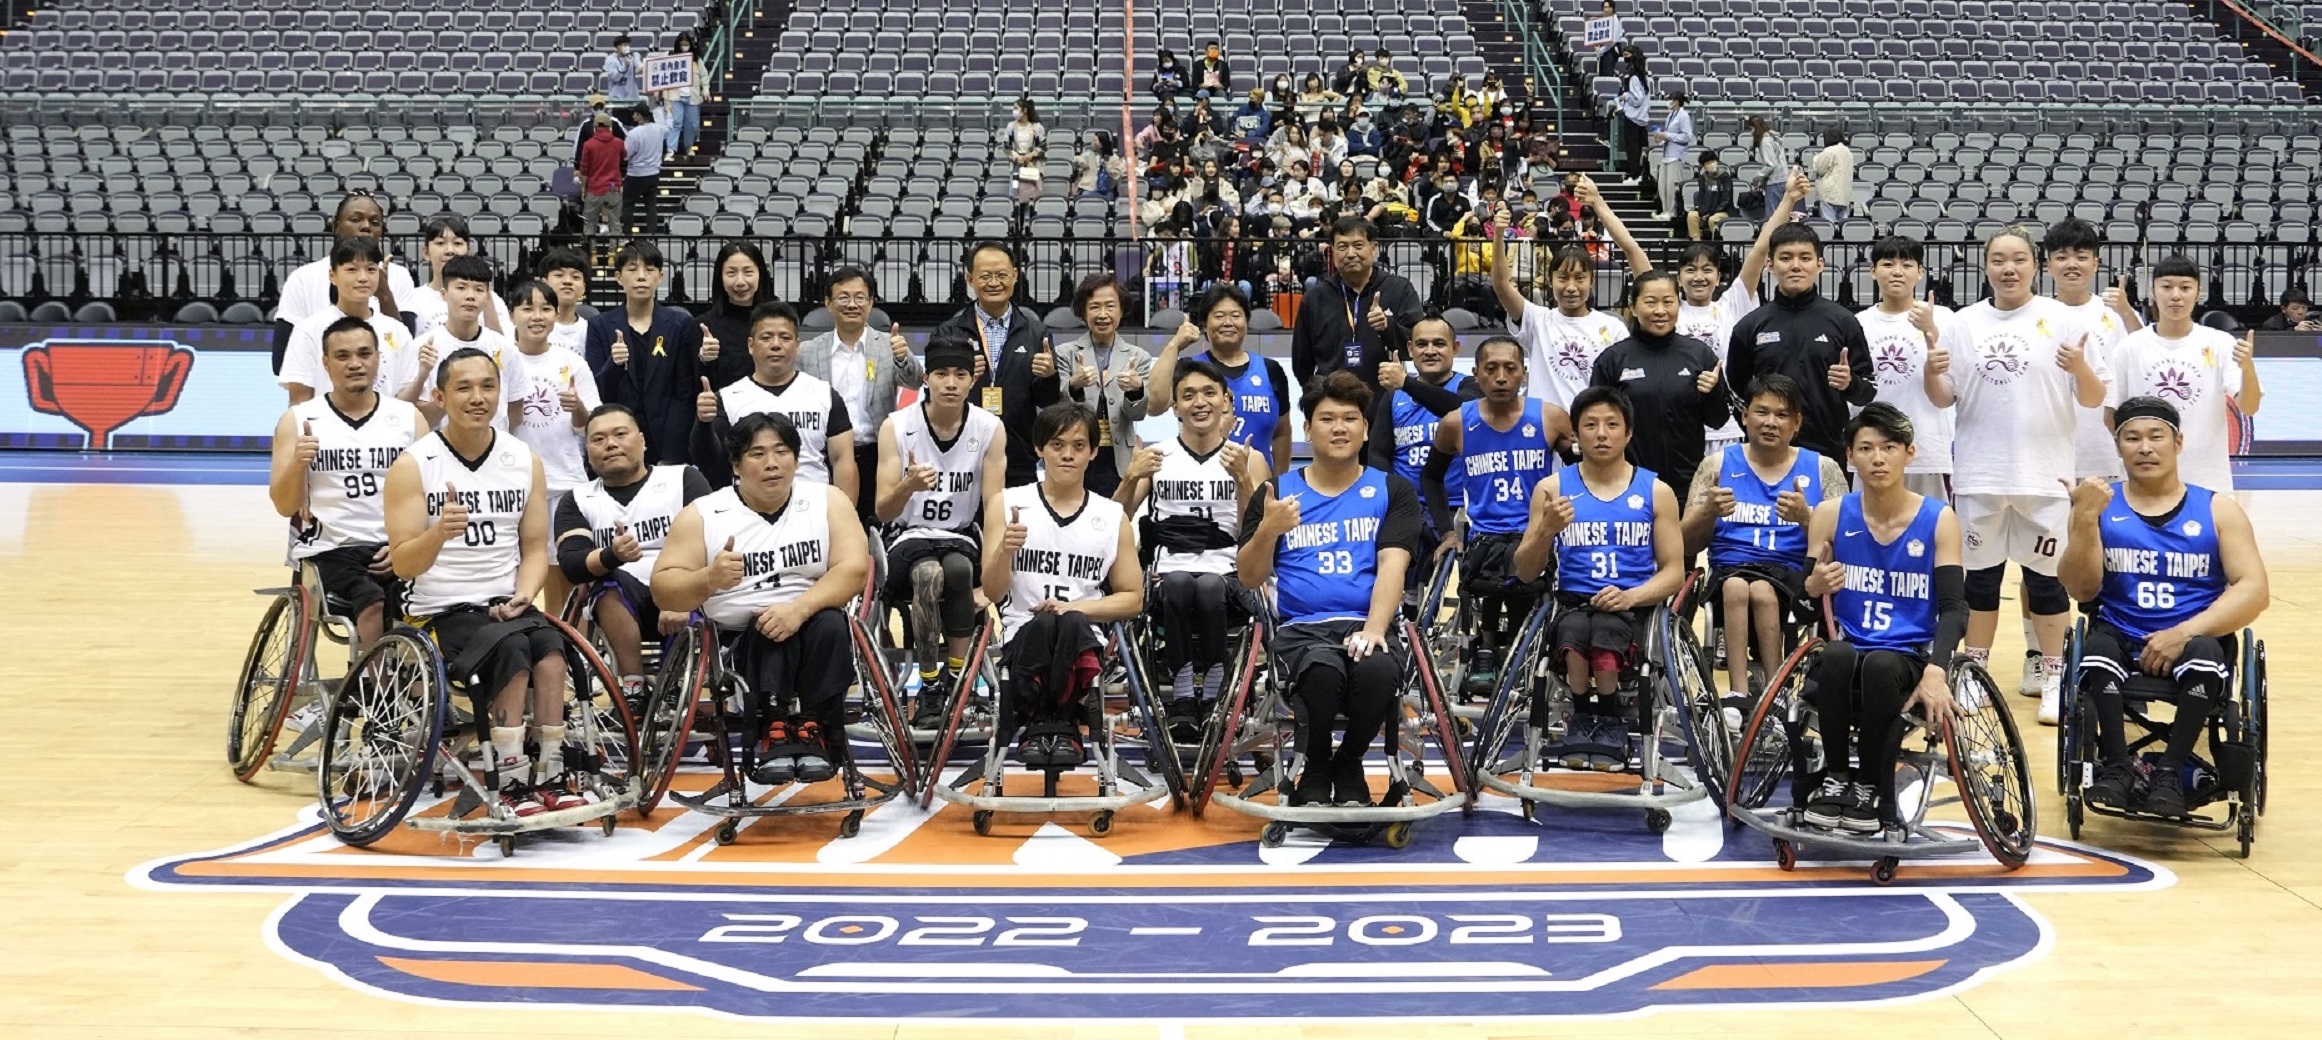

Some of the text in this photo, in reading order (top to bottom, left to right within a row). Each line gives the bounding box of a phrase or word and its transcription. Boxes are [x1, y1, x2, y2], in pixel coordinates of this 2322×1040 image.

[1241, 395, 1271, 414] TAIPEI
[788, 411, 821, 431] TAIPEI
[1229, 417, 1245, 437] 7
[369, 446, 407, 469] TAIP
[1465, 449, 1546, 477] CHINESE TAIPEI
[343, 472, 378, 499] 99
[949, 471, 975, 493] TAIP
[1157, 480, 1238, 501] CHINESE TAIP
[1494, 476, 1524, 502] 34
[487, 487, 525, 513] TAIPEI
[922, 499, 953, 521] 66
[464, 520, 496, 547] 00
[1614, 521, 1651, 547] TAIPEI
[1752, 527, 1776, 551] 11
[2033, 535, 2058, 558] 10
[743, 538, 822, 577] NESE TAIPEI
[1067, 553, 1104, 581] TAIPEI
[1318, 550, 1353, 574] 33
[1591, 552, 1619, 579] 31
[2104, 547, 2210, 578] CHINESE TAIPEI
[1843, 563, 1930, 600] HINESE TAIPEI
[2137, 581, 2175, 609] 66
[1861, 600, 1894, 631] 15
[698, 914, 1088, 946] 2022
[1248, 914, 1622, 946] 2023
